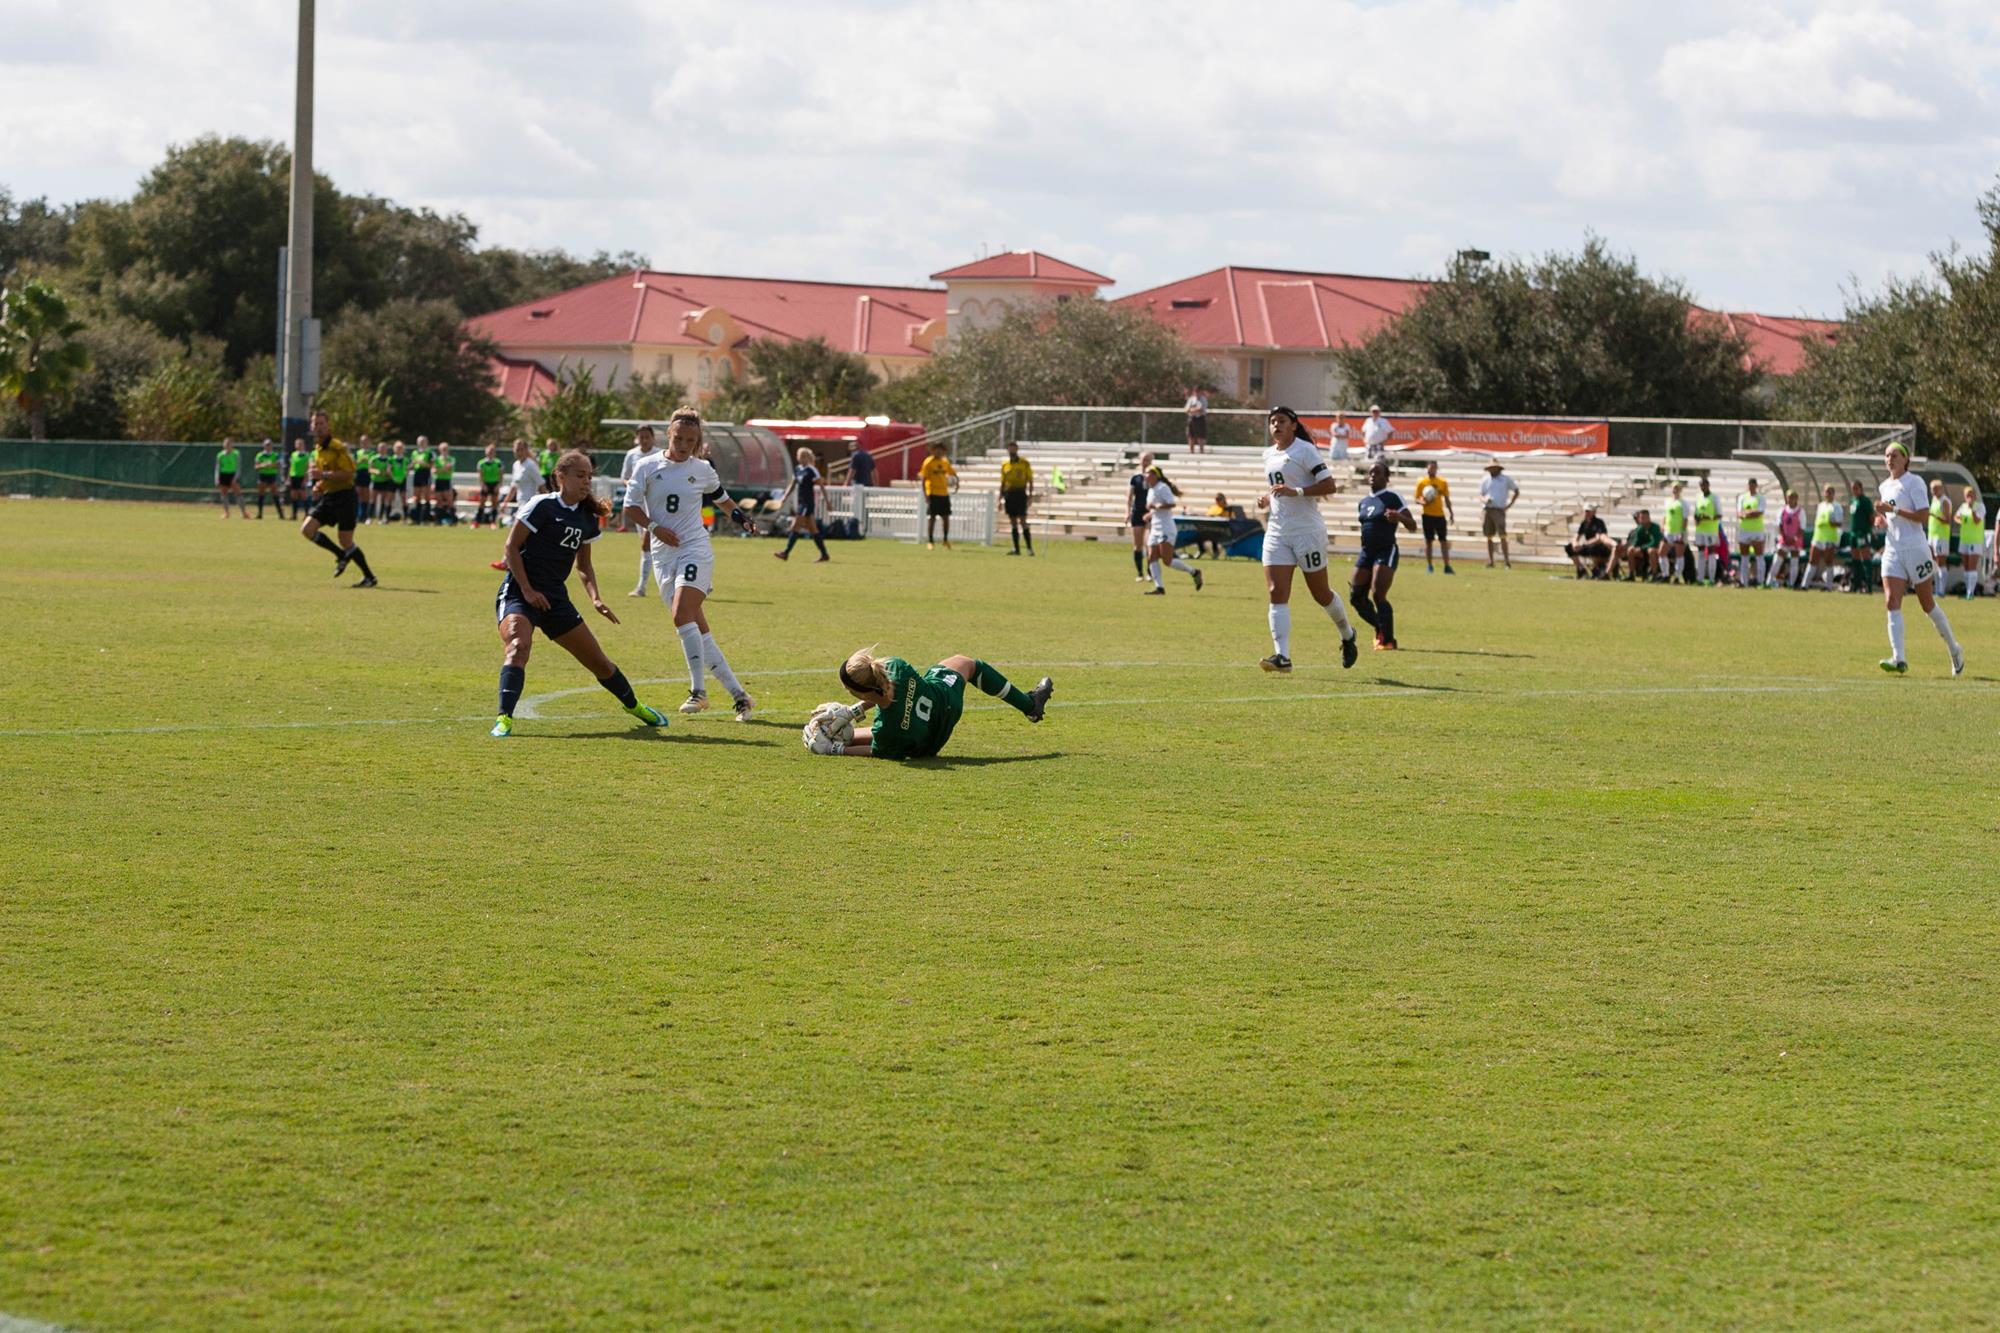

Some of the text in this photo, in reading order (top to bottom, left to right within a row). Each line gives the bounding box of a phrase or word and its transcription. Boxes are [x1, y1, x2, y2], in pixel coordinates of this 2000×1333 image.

[1446, 427, 1508, 443] Conference
[1510, 429, 1597, 449] Championships
[1268, 471, 1285, 486] 18
[666, 494, 680, 514] 8
[560, 526, 582, 550] 23
[1304, 551, 1321, 569] 18
[1915, 560, 1933, 579] 29
[684, 563, 698, 582] 8
[915, 695, 933, 722] 0
